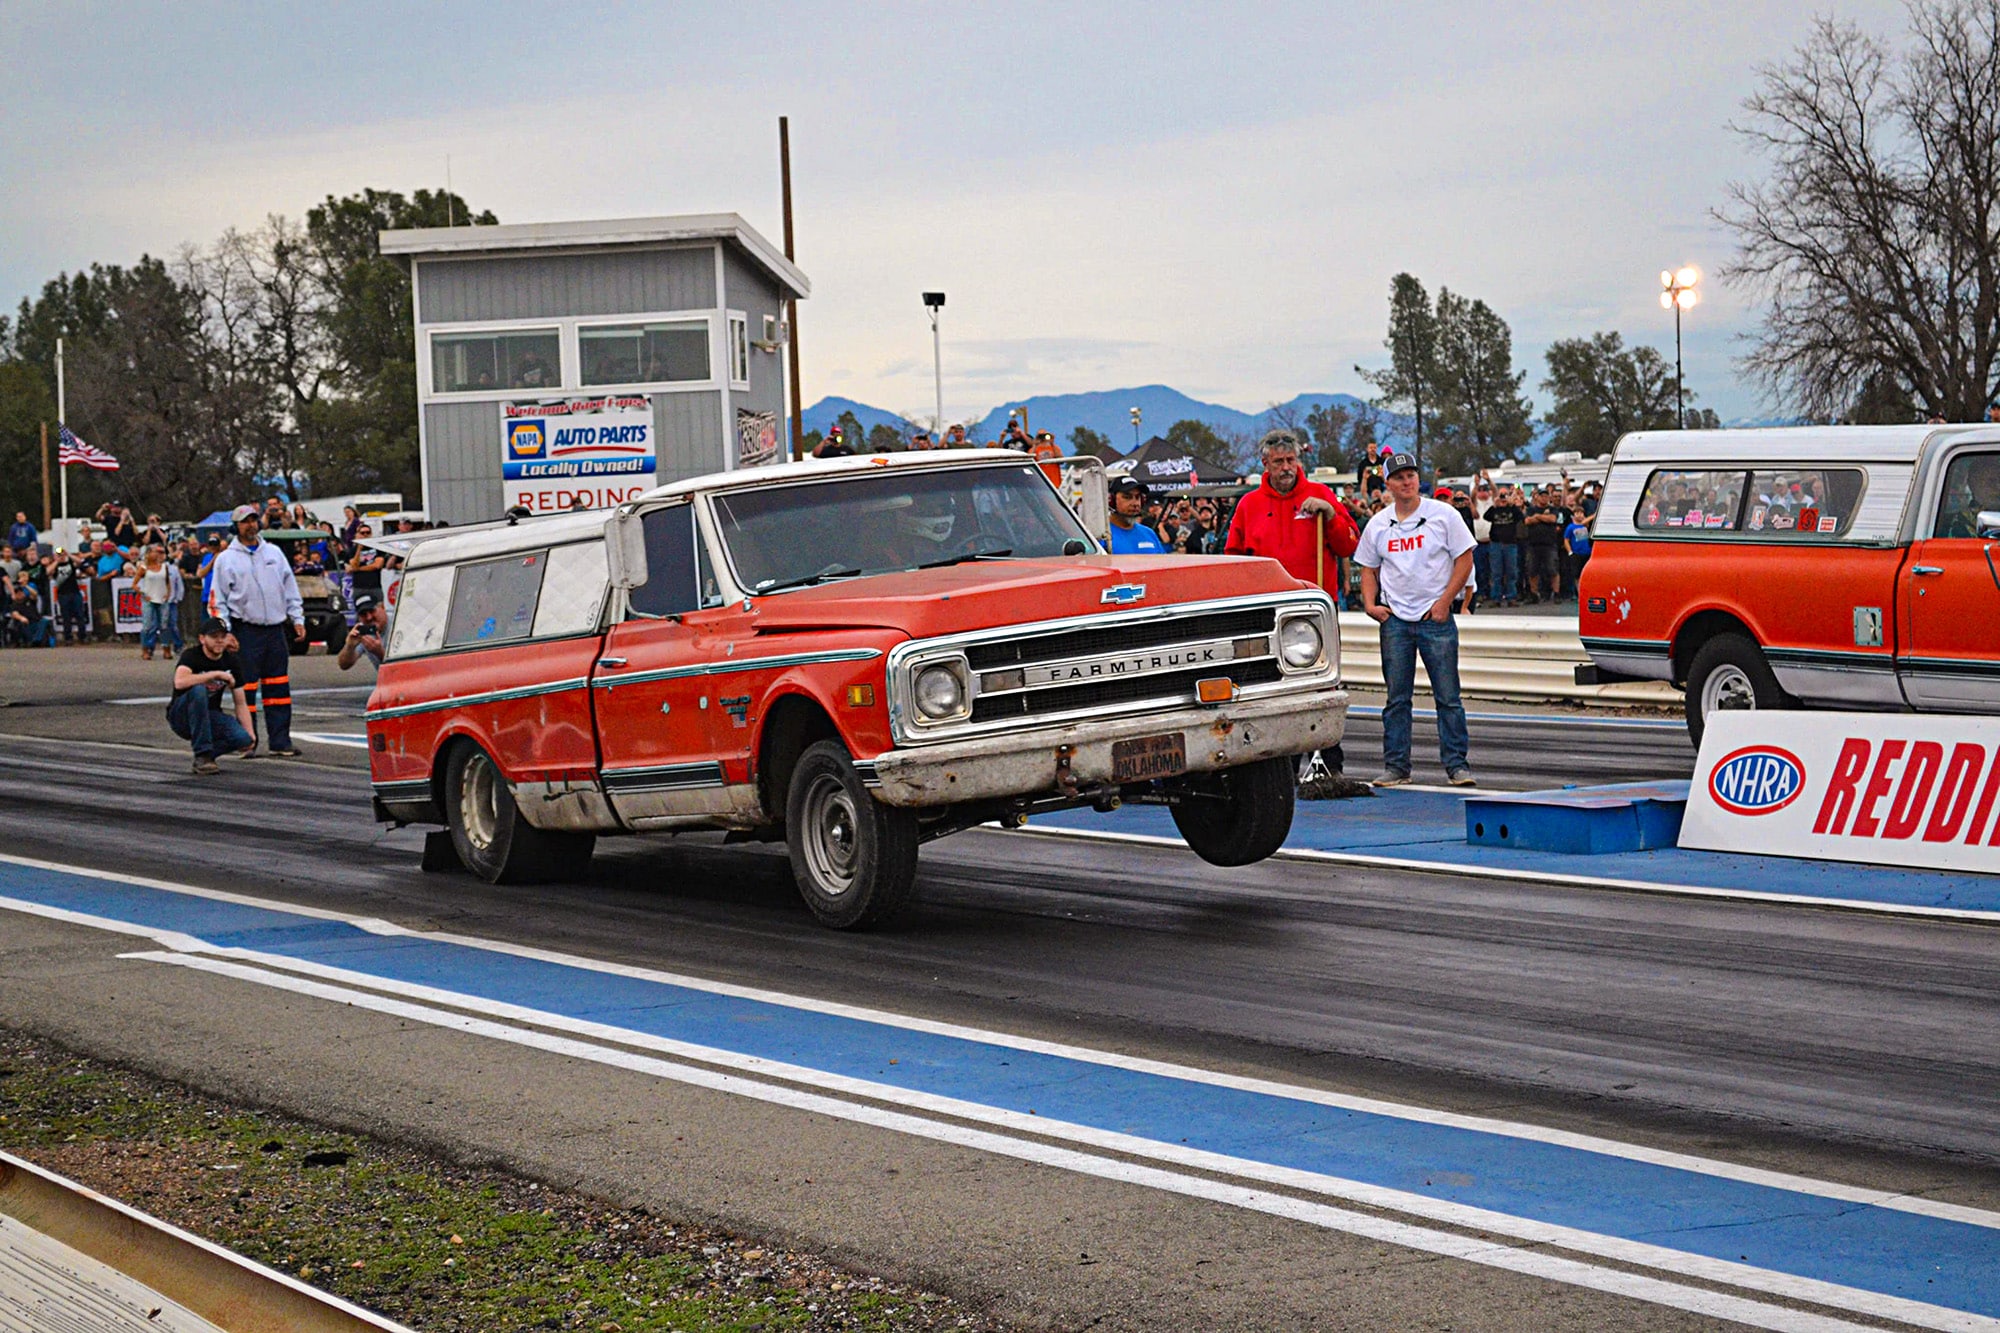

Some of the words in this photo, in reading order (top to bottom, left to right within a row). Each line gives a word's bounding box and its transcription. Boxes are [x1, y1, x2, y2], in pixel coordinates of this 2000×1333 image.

[572, 399, 605, 412] Race
[516, 432, 538, 447] NAPA
[554, 427, 596, 446] AUTO
[599, 425, 647, 443] PARTS
[520, 461, 578, 477] Locally
[581, 458, 643, 474] Owned!
[1387, 534, 1425, 553] EMT
[1051, 649, 1214, 680] FARMTRUCK
[1116, 751, 1182, 779] OKLAHOMA
[1720, 757, 1791, 804] NHRA
